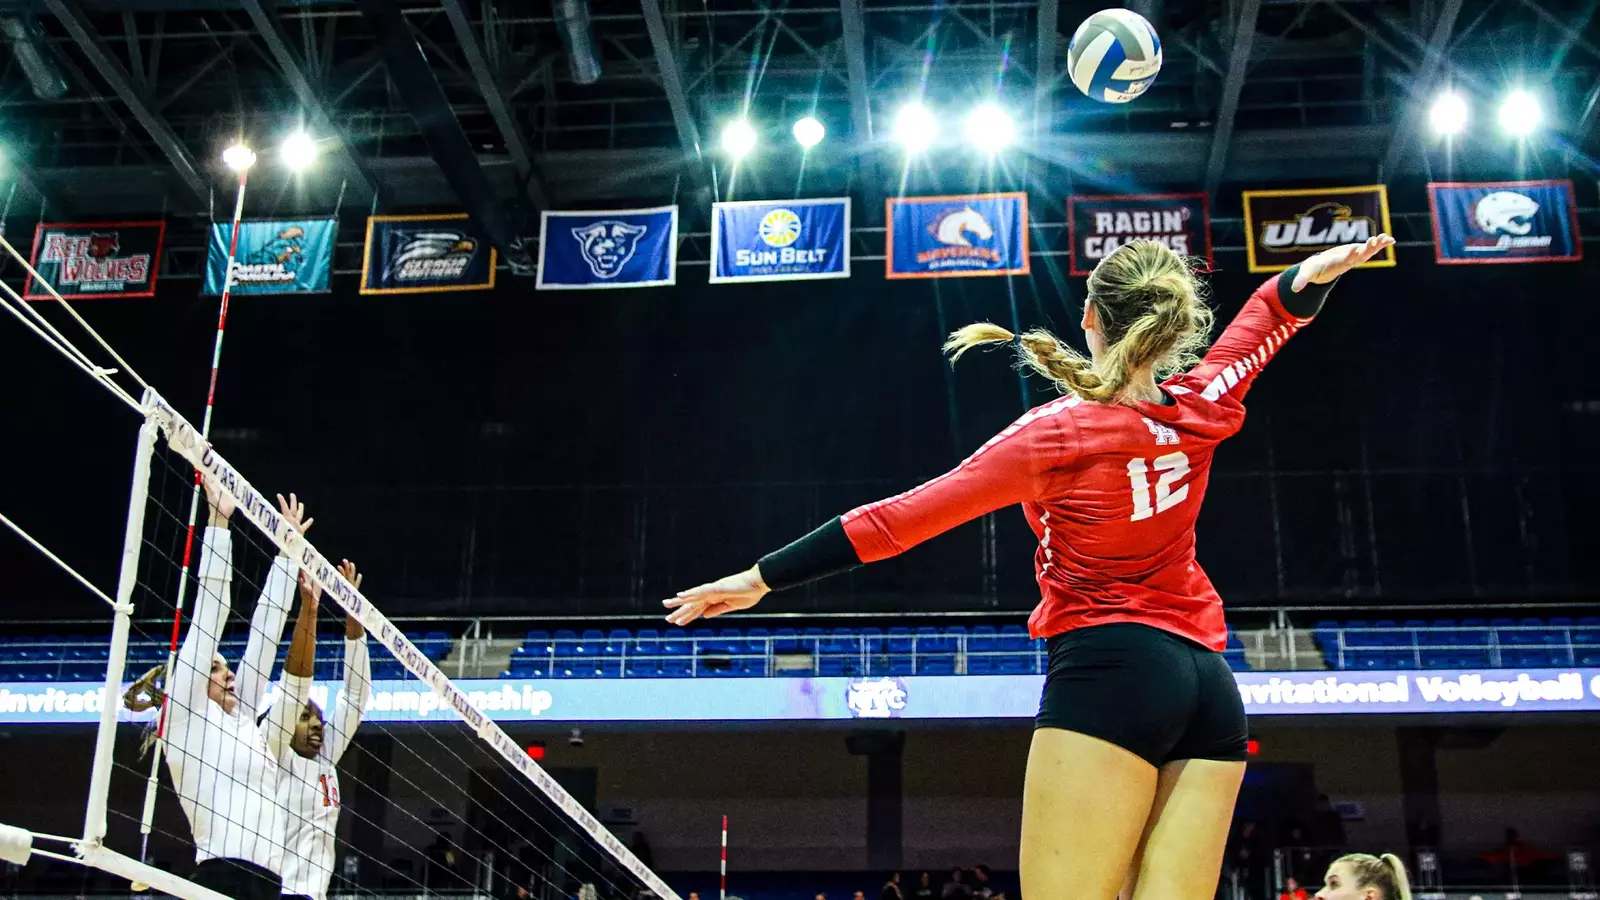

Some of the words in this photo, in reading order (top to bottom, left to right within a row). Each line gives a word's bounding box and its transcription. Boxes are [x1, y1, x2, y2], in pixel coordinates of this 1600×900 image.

[736, 248, 777, 267] SUN
[780, 247, 827, 265] BELT
[1084, 234, 1189, 259] CAS
[59, 254, 150, 286] WOLVES
[1126, 450, 1192, 523] 12
[1236, 675, 1409, 705] nvitational
[1416, 672, 1584, 708] Volleyball
